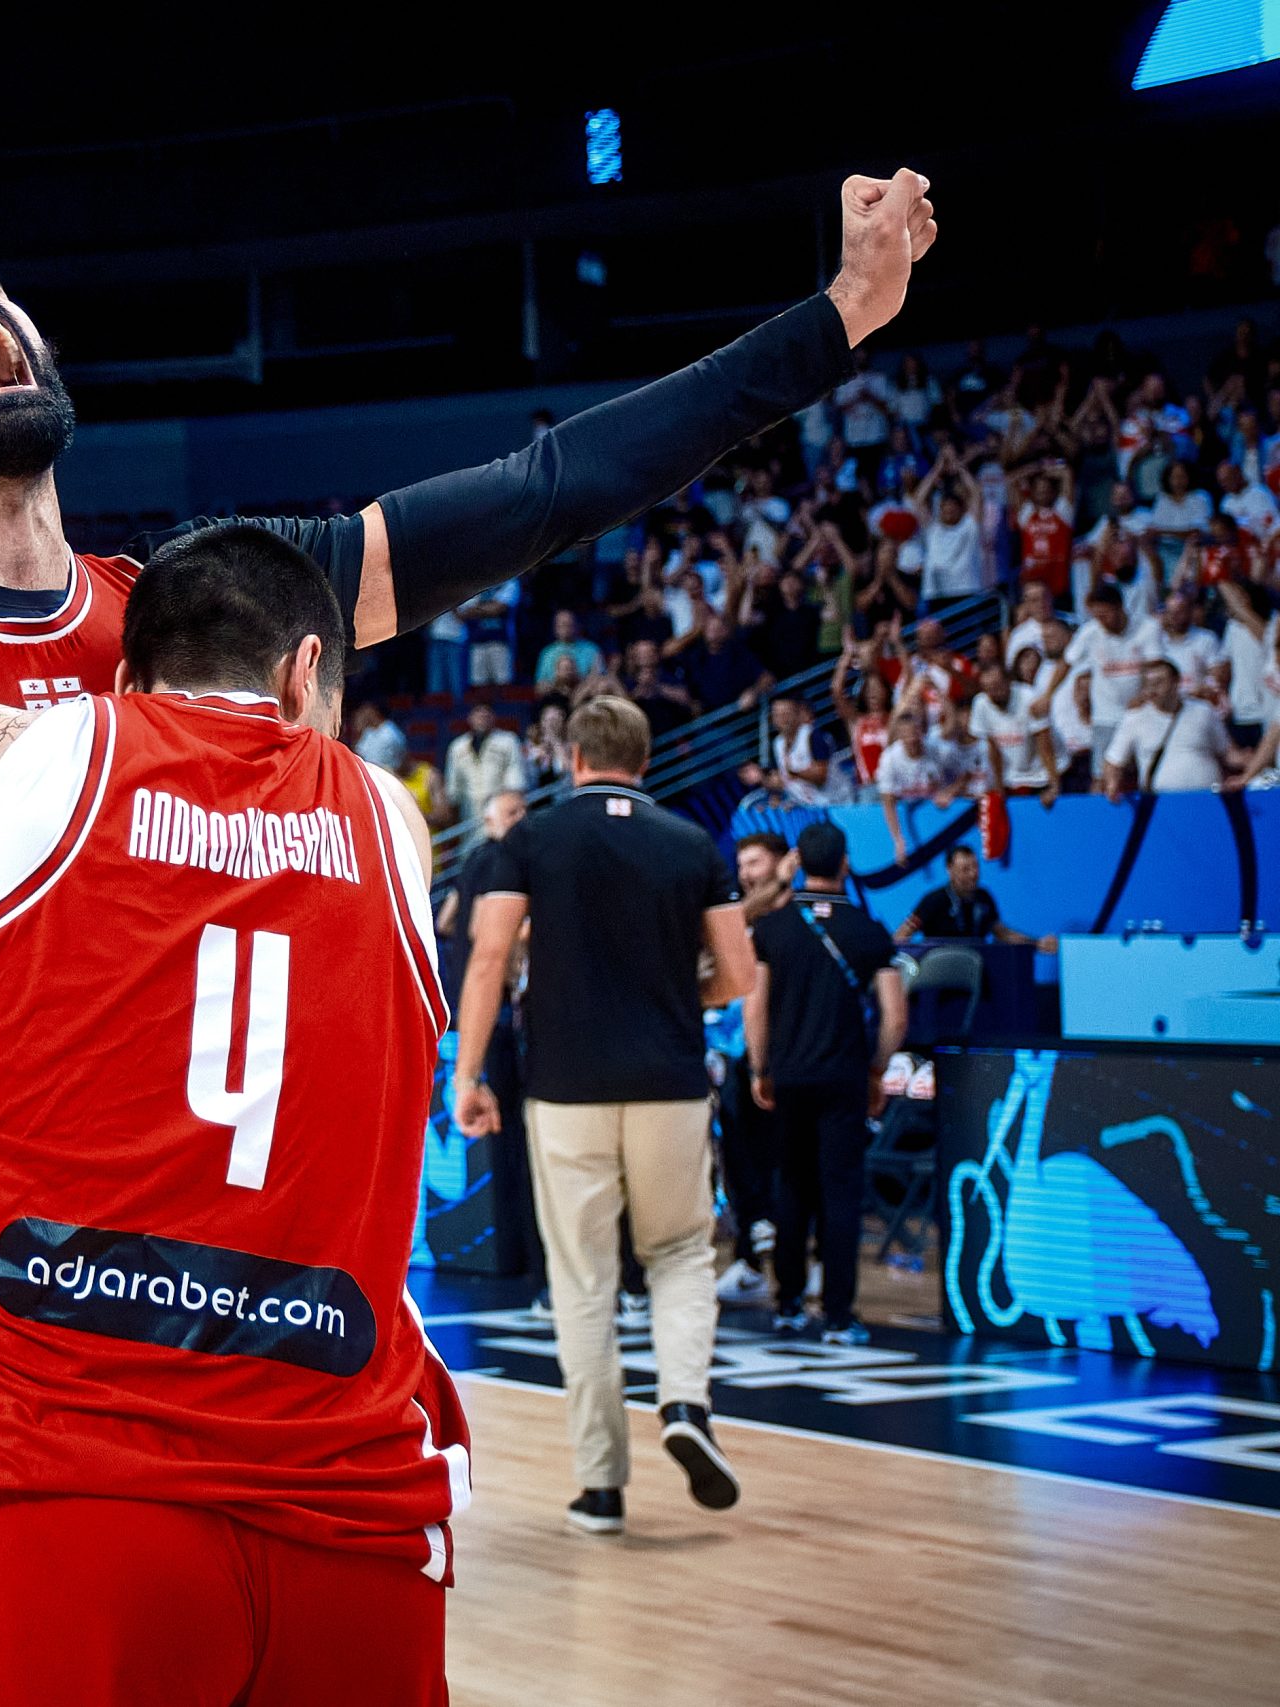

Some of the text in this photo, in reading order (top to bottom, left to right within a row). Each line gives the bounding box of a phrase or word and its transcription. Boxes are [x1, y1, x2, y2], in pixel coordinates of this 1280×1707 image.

[128, 787, 361, 885] ANDRONIKASHVILI
[186, 923, 291, 1191] 4
[26, 1253, 346, 1338] adjarabet.com
